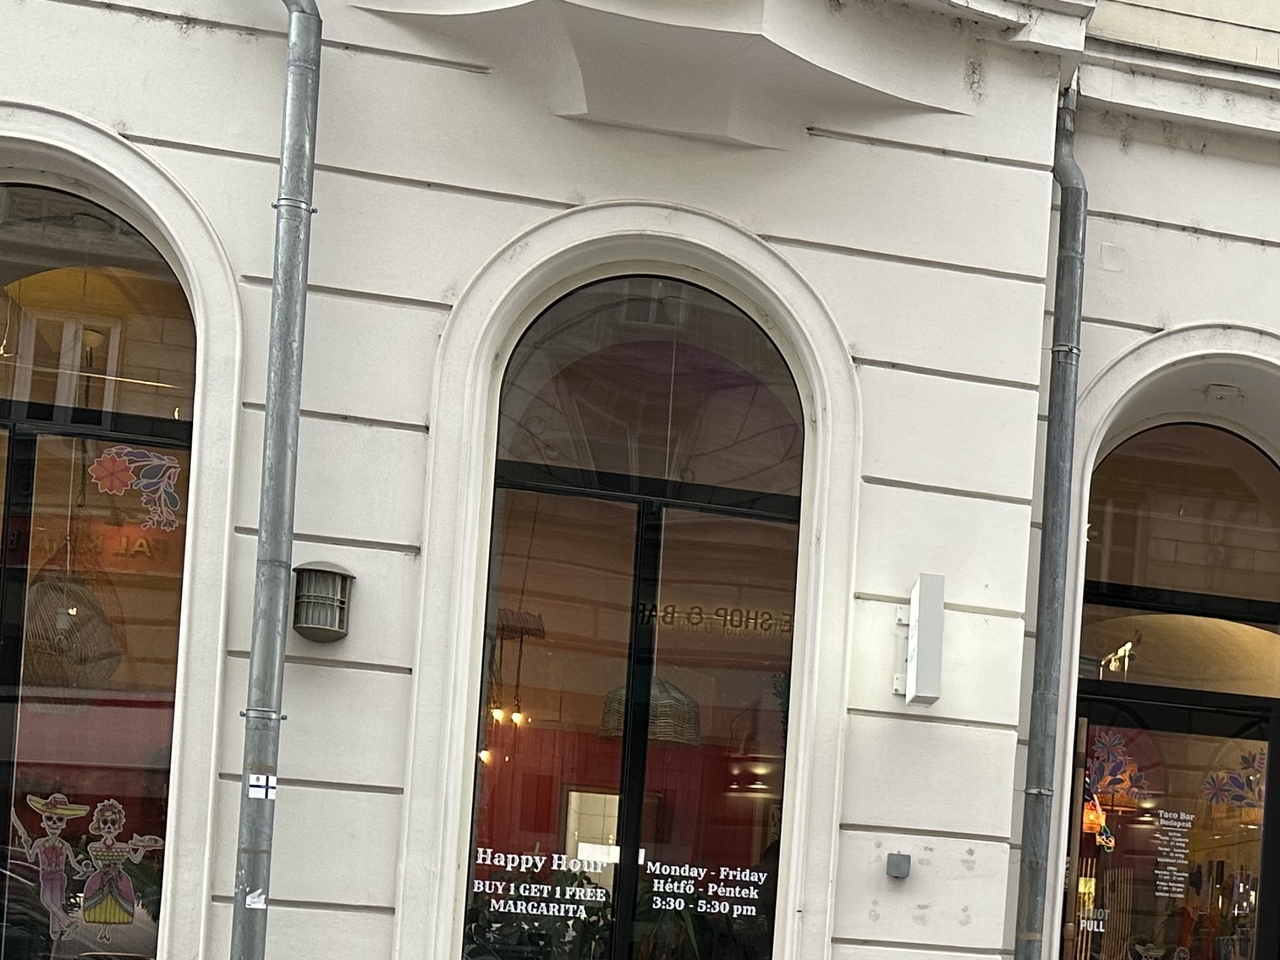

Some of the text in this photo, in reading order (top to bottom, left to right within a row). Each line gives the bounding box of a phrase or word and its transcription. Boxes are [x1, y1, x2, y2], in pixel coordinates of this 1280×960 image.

[1158, 810, 1195, 820] Taco Bar
[1160, 819, 1192, 828] Budapest
[475, 848, 607, 874] Happy Hour
[646, 861, 707, 881] Monday
[719, 867, 768, 884] Friday
[473, 879, 606, 902] BUY 1 GET 1 FREE
[653, 878, 694, 895] Hétfő
[707, 883, 759, 899] Péntek
[489, 899, 587, 919] MARGARITA
[652, 896, 685, 911] 3:30
[697, 899, 729, 914] 5:30
[732, 904, 757, 917] pm
[1080, 920, 1105, 933] PULL
